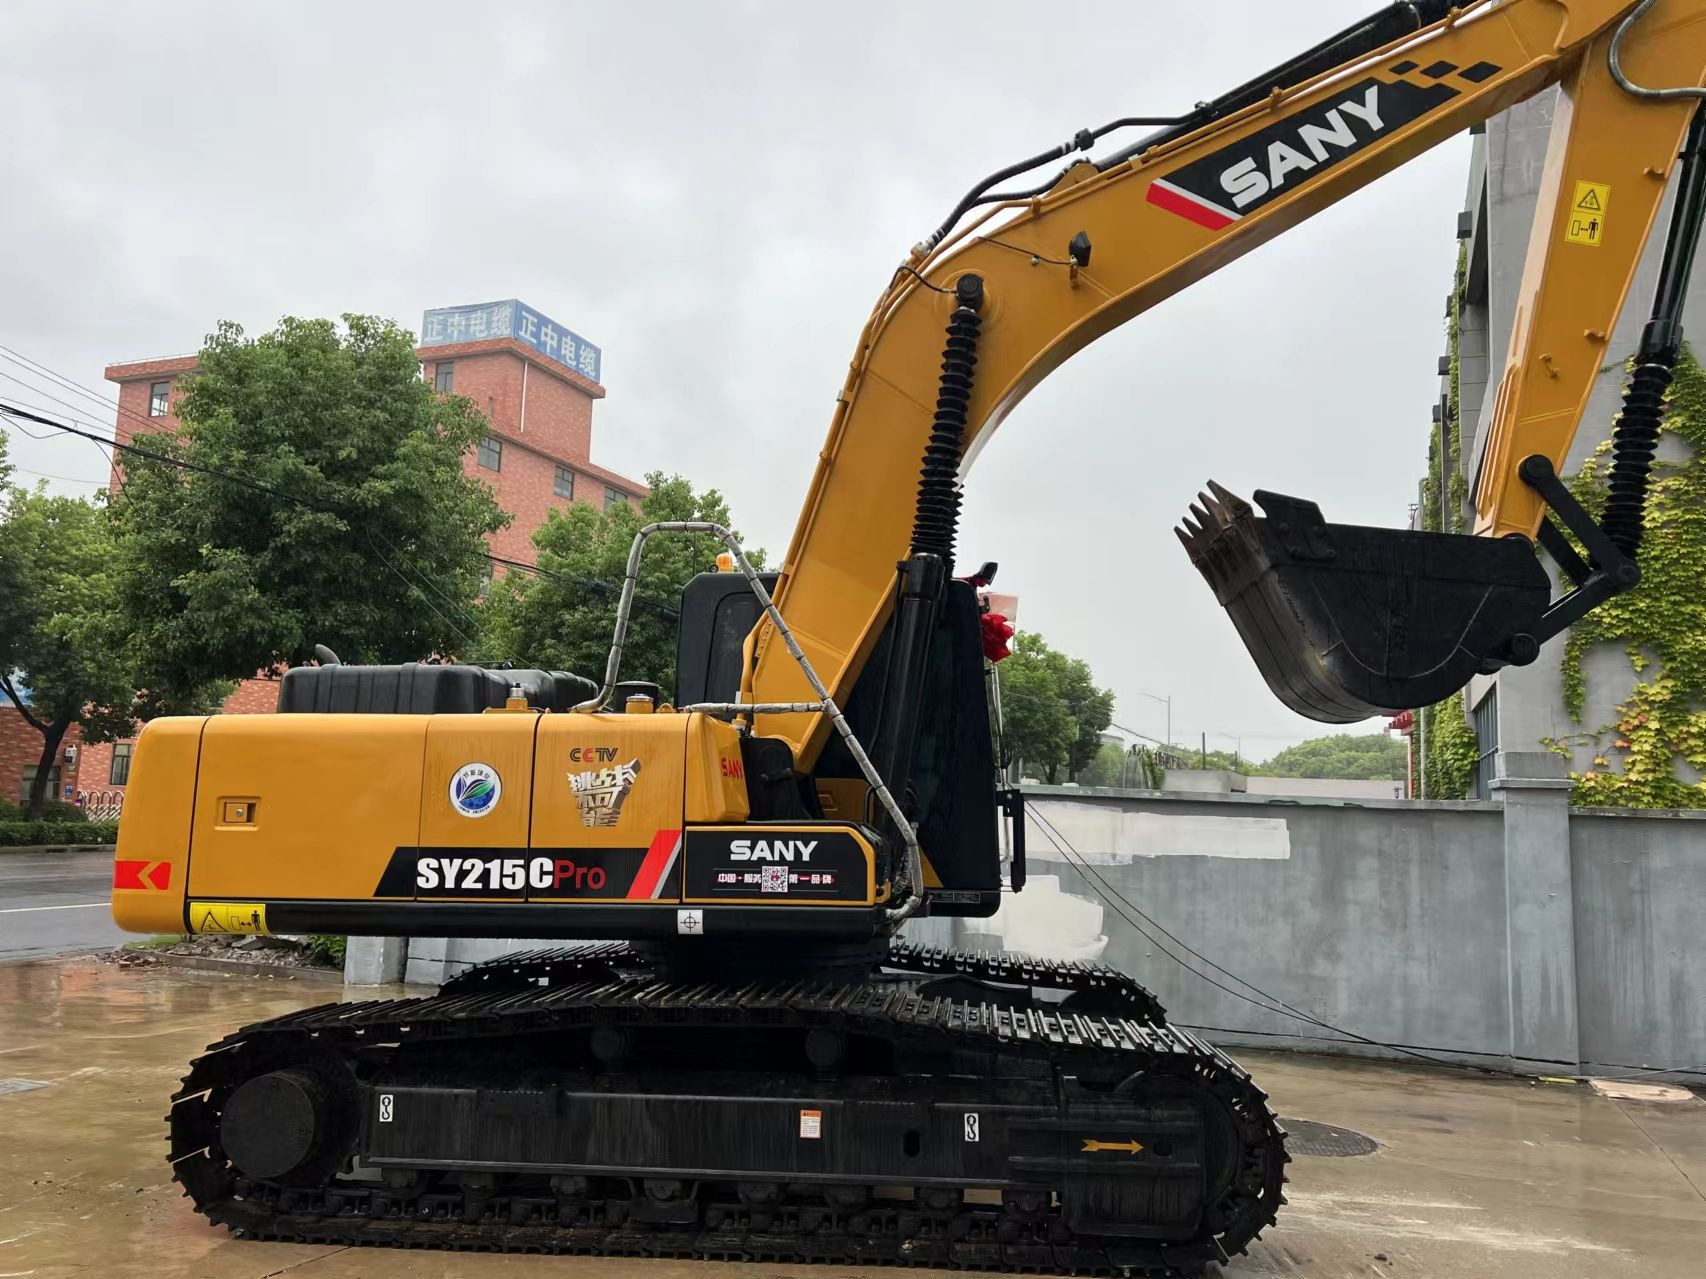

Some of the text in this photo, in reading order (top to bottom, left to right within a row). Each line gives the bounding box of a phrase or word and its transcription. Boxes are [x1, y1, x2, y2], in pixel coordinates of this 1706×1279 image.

[1219, 85, 1385, 209] SANY
[518, 310, 597, 377] 正中电缆
[570, 747, 618, 763] CCTV
[730, 839, 818, 862] SANY
